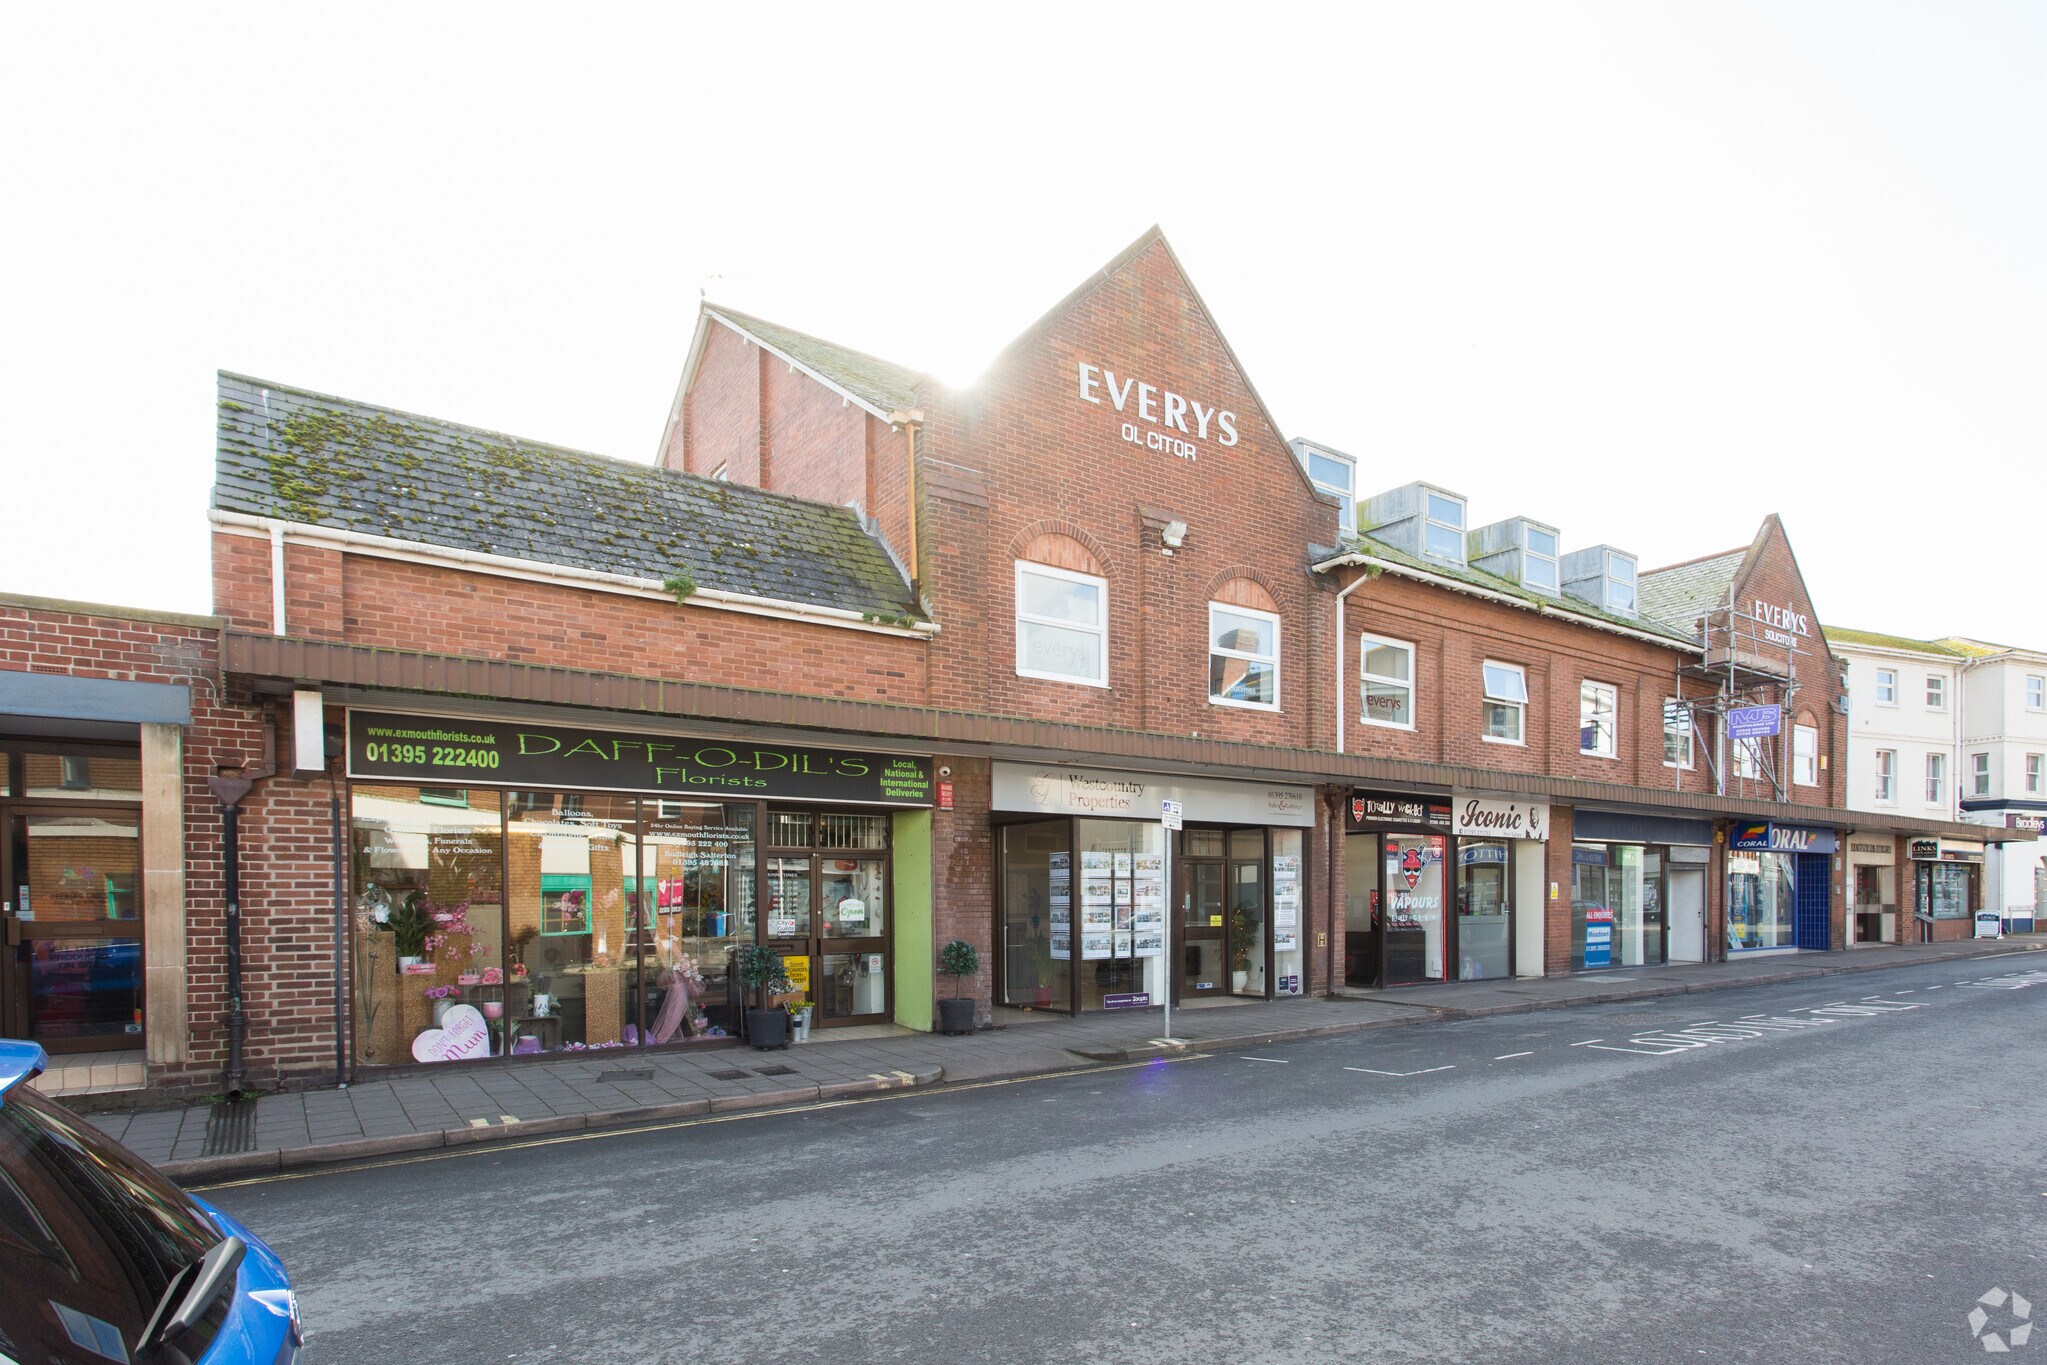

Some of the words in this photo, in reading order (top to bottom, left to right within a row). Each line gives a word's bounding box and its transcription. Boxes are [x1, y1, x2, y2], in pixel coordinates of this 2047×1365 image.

[1079, 362, 1239, 447] EVERYS
[1147, 431, 1196, 461] CITOR
[1755, 599, 1807, 635] EVERYS
[1033, 641, 1086, 668] everys
[1366, 695, 1401, 716] everys
[1731, 708, 1777, 725] MJS
[367, 726, 495, 744] www.exmouthflorists.co.uk
[366, 742, 426, 764] 01395
[432, 747, 499, 768] 222400
[893, 760, 916, 770] Local,
[656, 767, 767, 788] Florists
[880, 778, 928, 788] International
[884, 769, 916, 778] National
[885, 788, 923, 797] Deliveries
[1068, 775, 1145, 797] Westcountry
[1069, 791, 1131, 811] Properties
[552, 809, 594, 817] Balloons,
[1460, 800, 1521, 829] Iconic
[434, 826, 472, 834] Florists
[1771, 828, 1808, 850] ORAL
[841, 907, 864, 918] Open
[1390, 897, 1439, 910] VAPOURS
[1318, 934, 1326, 946] H
[448, 1015, 474, 1038] FORGET
[441, 1029, 487, 1060] Mum
